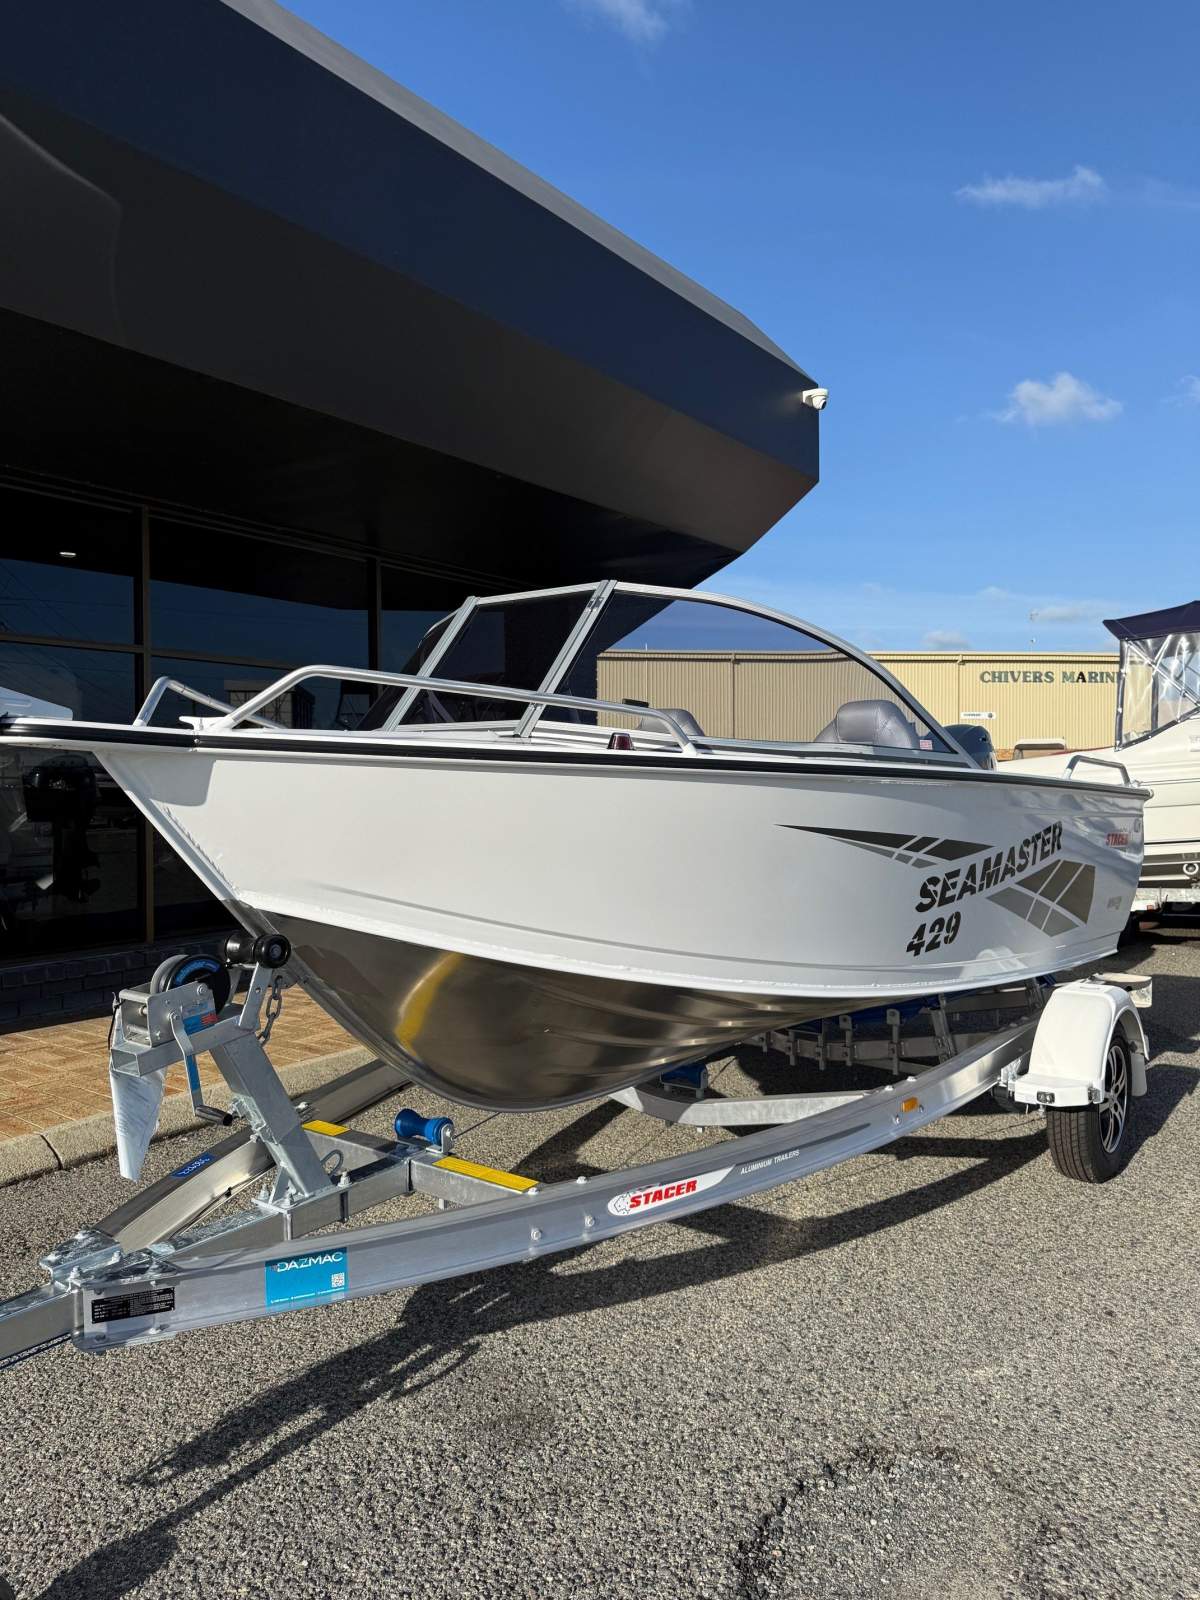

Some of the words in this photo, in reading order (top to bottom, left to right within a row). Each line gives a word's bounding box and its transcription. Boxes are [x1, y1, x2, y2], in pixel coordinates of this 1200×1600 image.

[980, 670, 1055, 683] CHIVERS
[1061, 671, 1119, 683] MARIN
[914, 820, 1063, 913] SEAMASTER
[905, 911, 962, 957] 429
[774, 1149, 800, 1165] TRAILERS
[629, 1179, 698, 1209] STACER
[277, 1251, 344, 1273] DAZMAC
